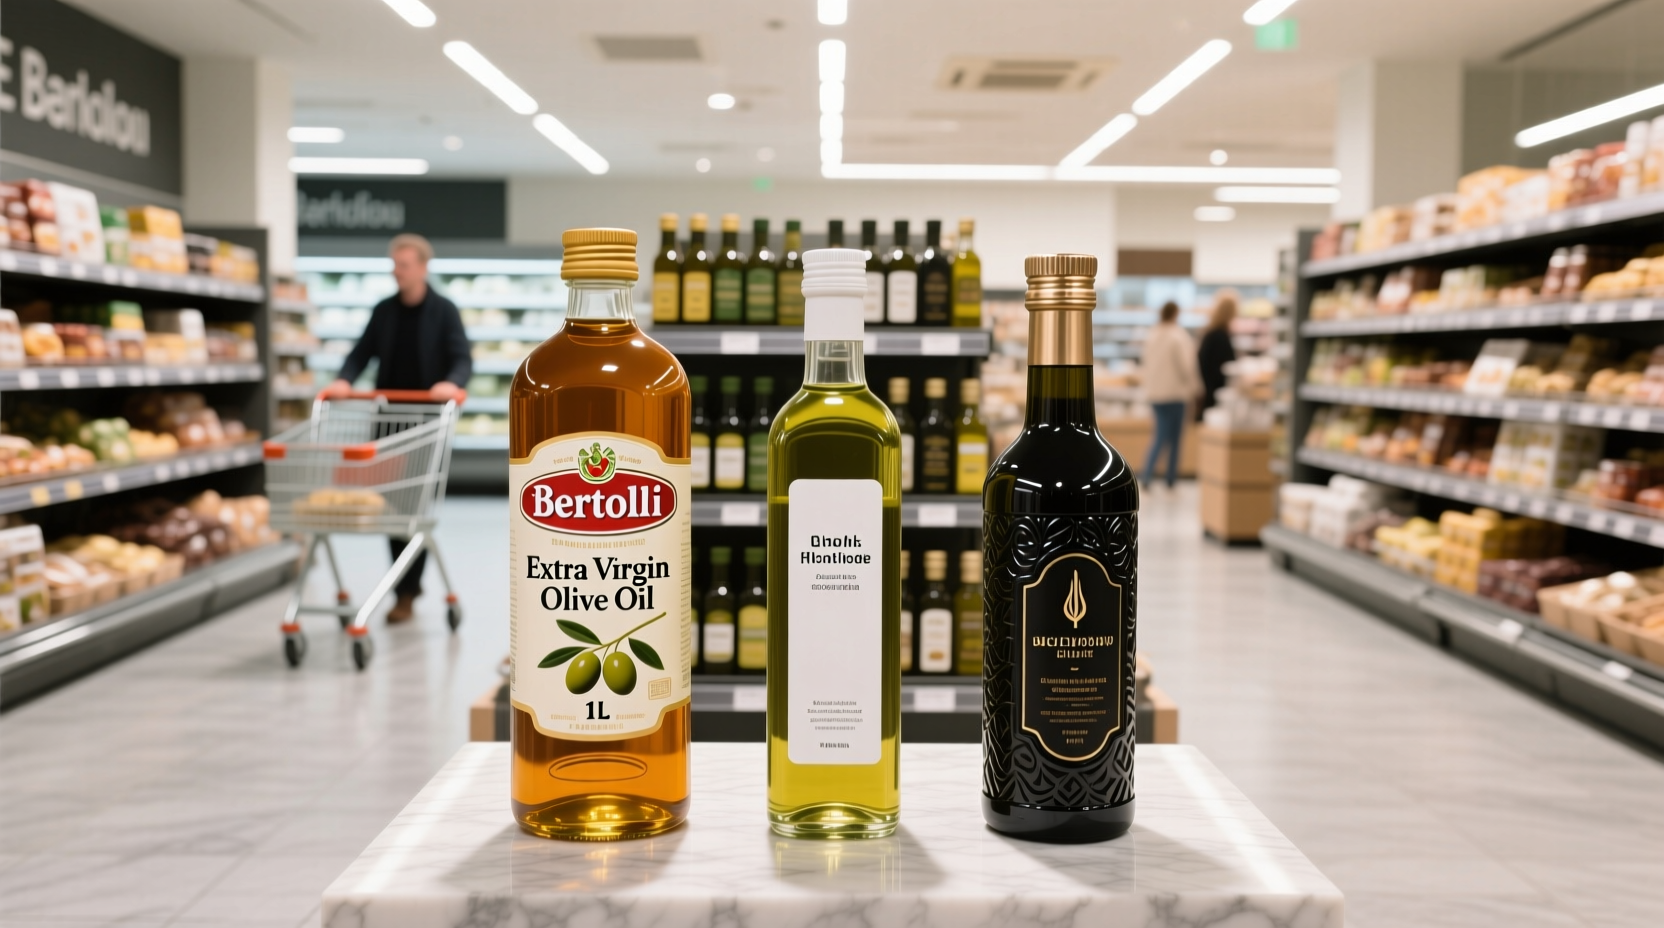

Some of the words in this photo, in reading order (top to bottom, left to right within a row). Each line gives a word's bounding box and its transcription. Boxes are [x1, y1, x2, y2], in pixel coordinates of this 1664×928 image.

[533, 484, 662, 519] Bertolli
[527, 556, 587, 580] Extra
[593, 556, 670, 586] Virgin
[541, 586, 608, 611] Olive
[615, 585, 654, 610] Oil
[586, 701, 610, 719] 1L
